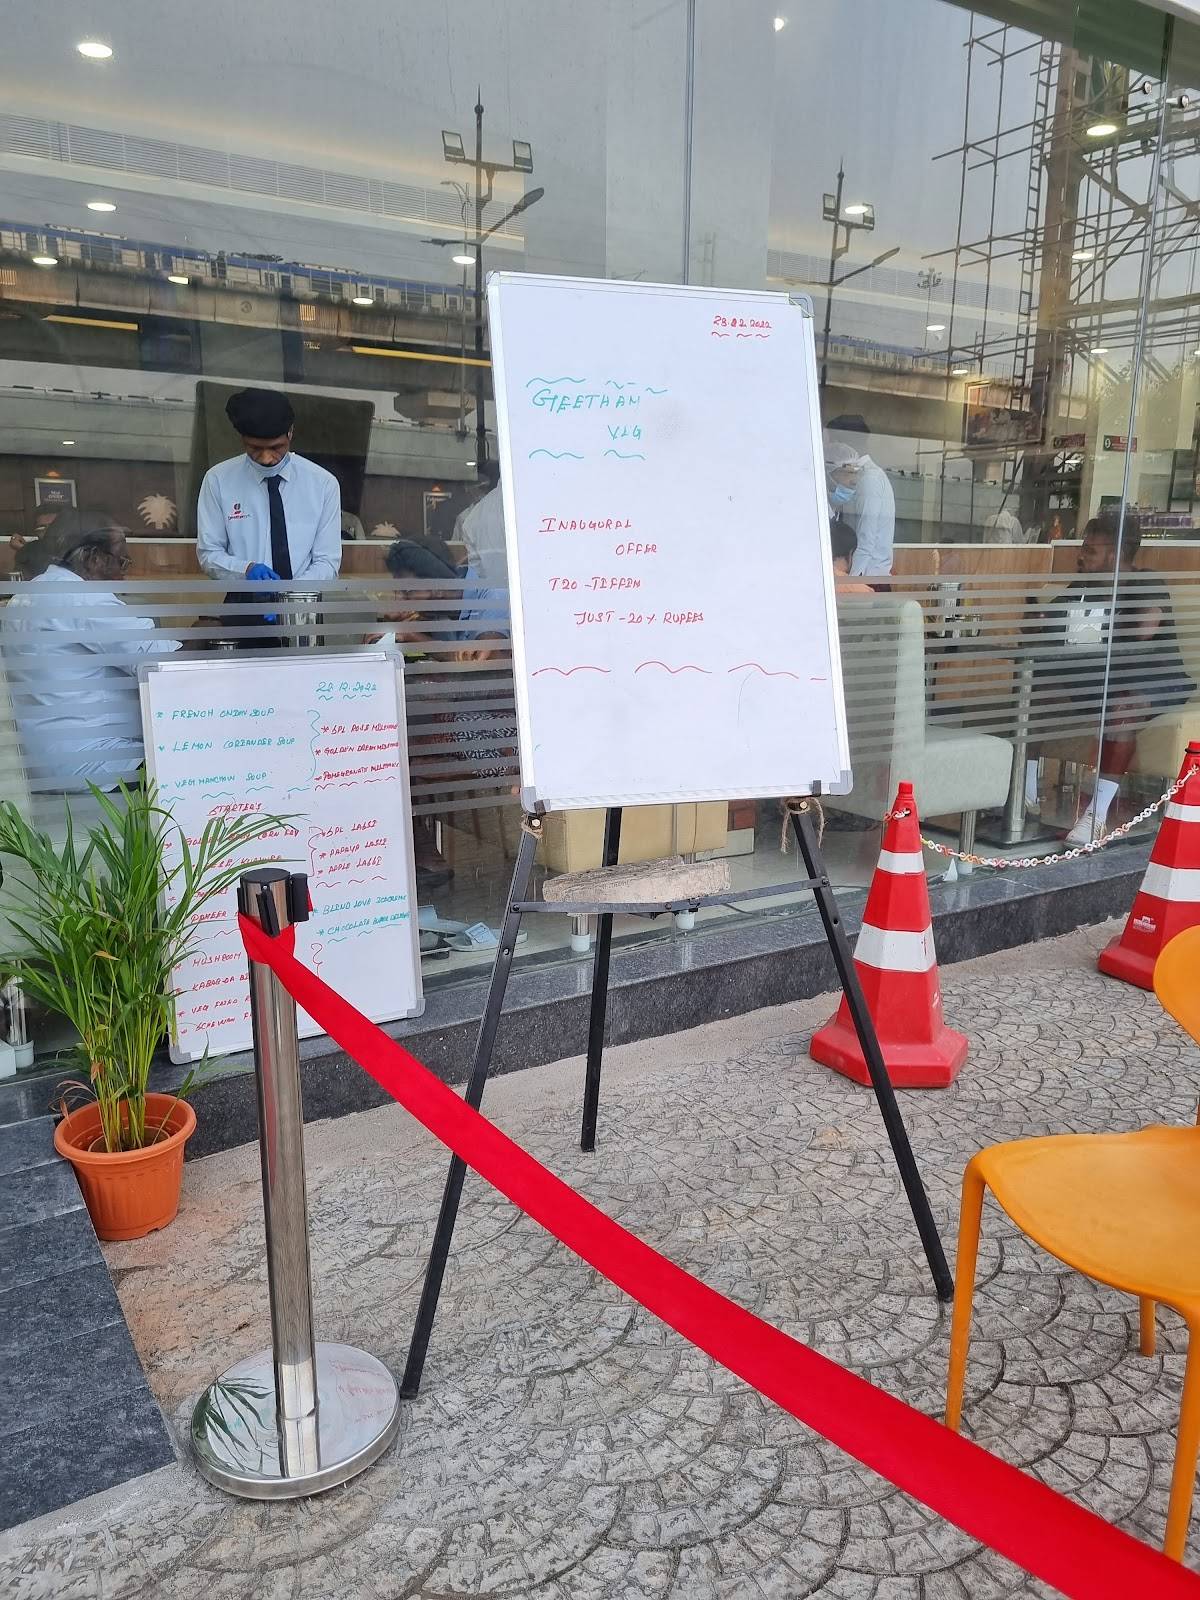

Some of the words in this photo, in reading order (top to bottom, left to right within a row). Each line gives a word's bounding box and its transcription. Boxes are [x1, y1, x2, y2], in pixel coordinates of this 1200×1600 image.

[538, 517, 632, 533] INAUGURAL
[615, 542, 658, 556] OFFER
[548, 577, 578, 591] T20
[573, 610, 616, 625] JUST
[663, 611, 704, 625] RUPEES
[171, 707, 215, 721] FRENCH
[173, 741, 213, 752] LEMON
[223, 737, 273, 749] CORIANDER
[277, 736, 296, 746] SOUP
[245, 772, 268, 782] SOUP
[327, 918, 370, 935] CHOCOLATE
[192, 951, 242, 967] MUSHROOM
